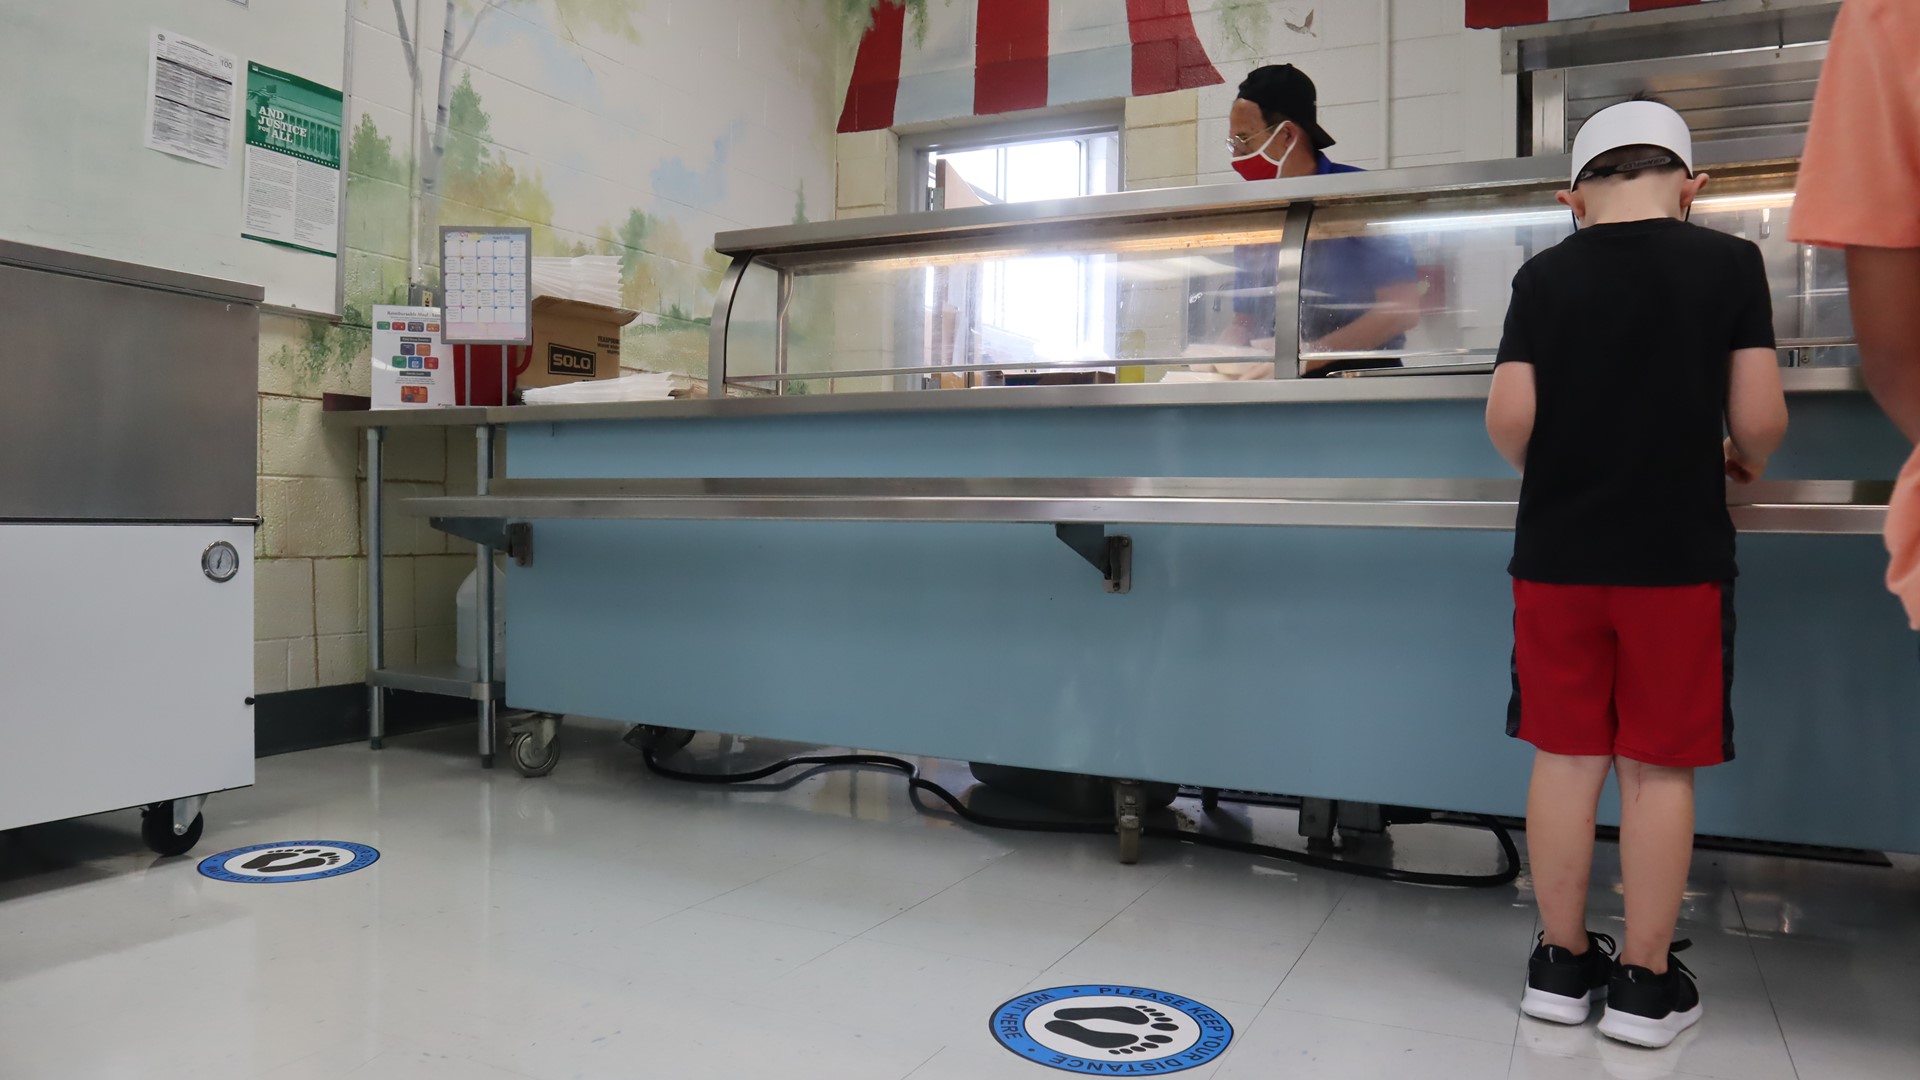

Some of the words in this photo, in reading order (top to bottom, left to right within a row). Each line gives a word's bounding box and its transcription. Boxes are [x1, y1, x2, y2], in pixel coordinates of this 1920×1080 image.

[259, 106, 285, 120] AND
[258, 116, 307, 137] JUSTICE
[258, 125, 270, 133] FOR
[272, 130, 293, 143] ALL
[553, 353, 591, 370] SOLO
[226, 874, 272, 882] HERE
[1011, 993, 1055, 1012] WAIT
[1099, 987, 1189, 1007] PLEASE
[1000, 1012, 1023, 1040] HERE
[1188, 1006, 1224, 1032] KEEP
[1183, 1035, 1224, 1061] YOUR
[1049, 1054, 1184, 1073] DISTANCE
